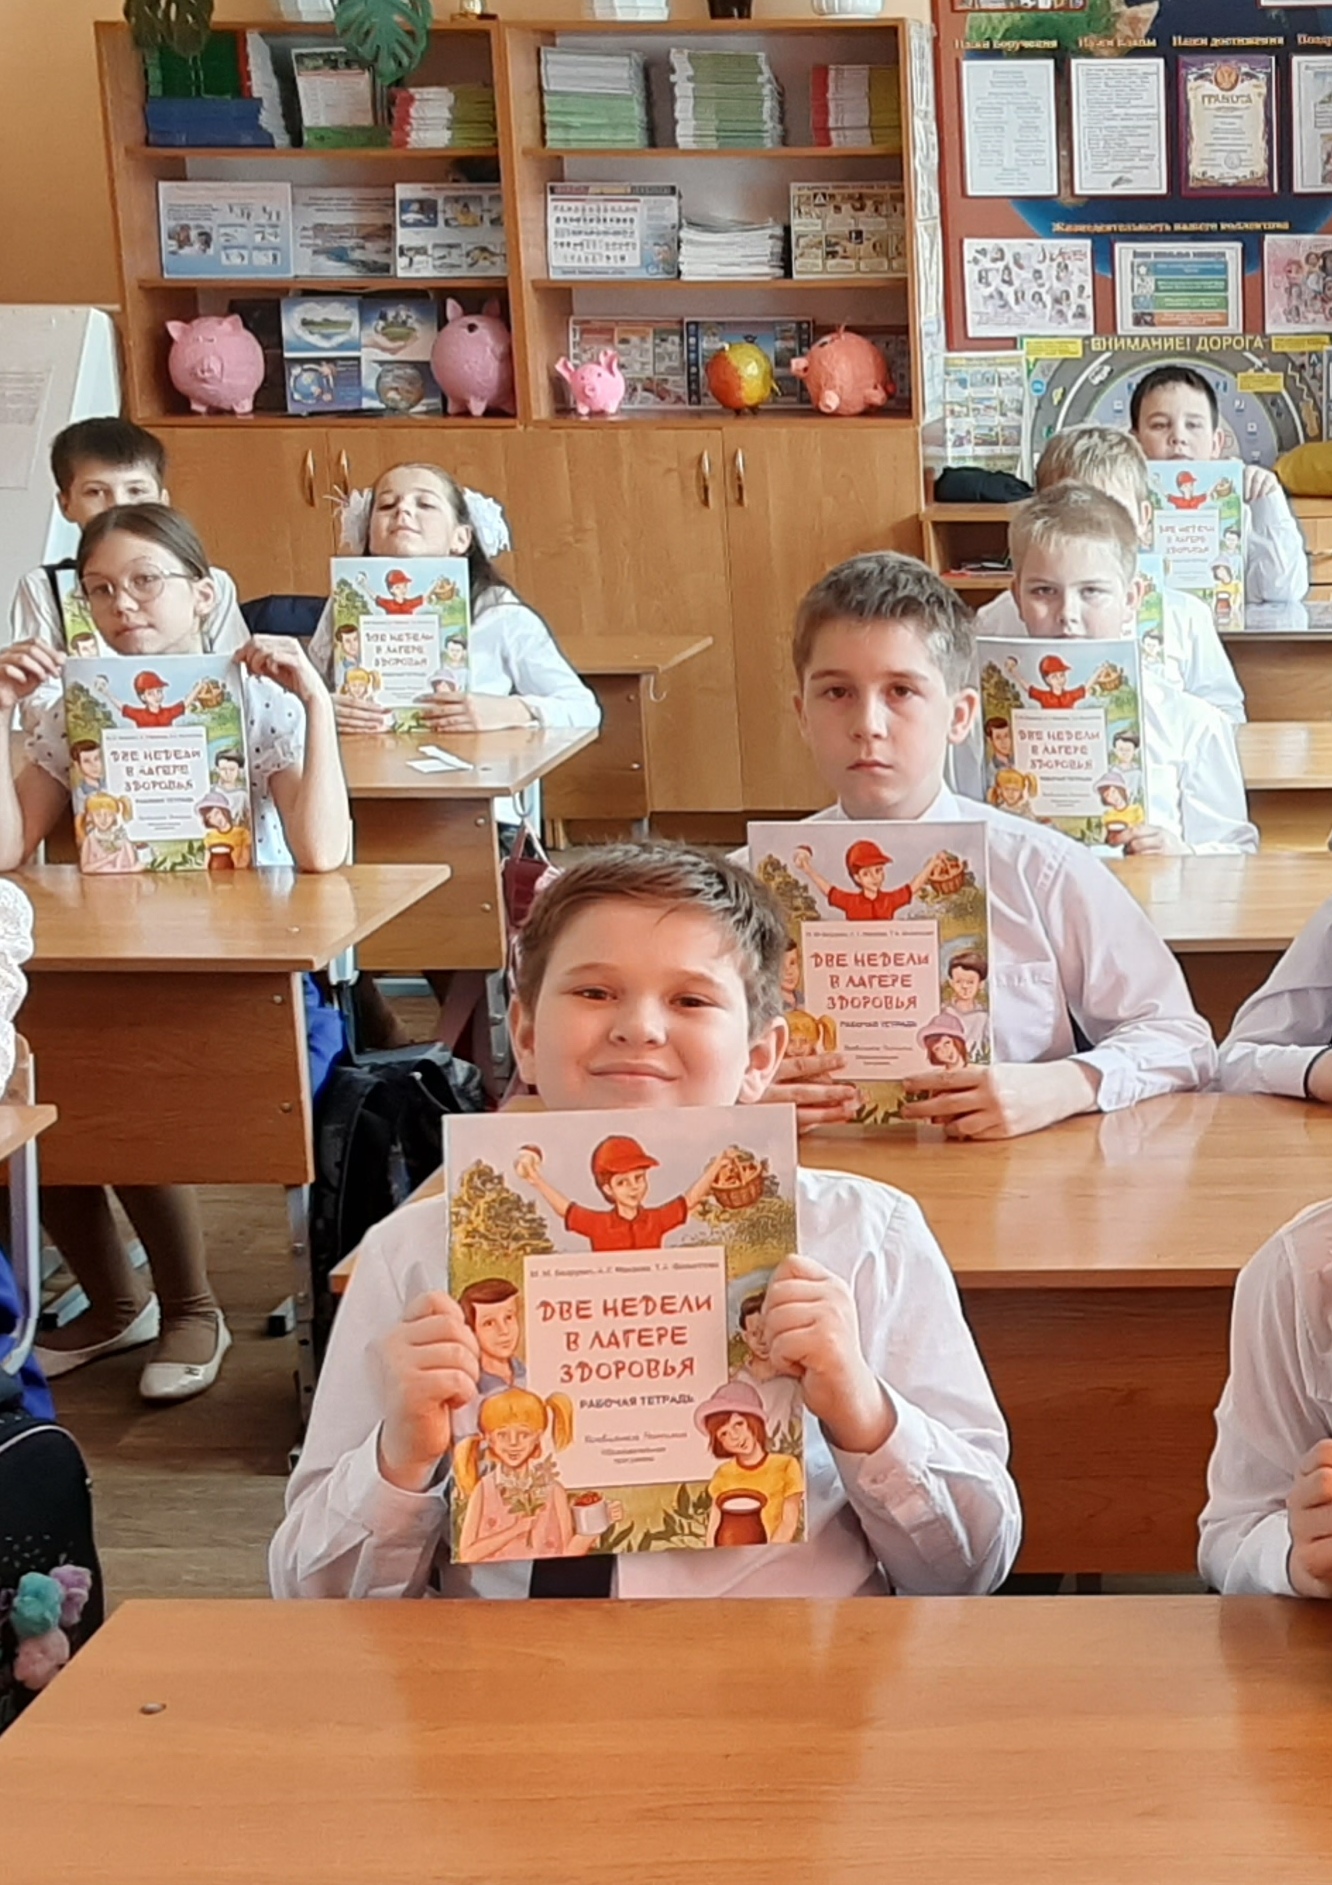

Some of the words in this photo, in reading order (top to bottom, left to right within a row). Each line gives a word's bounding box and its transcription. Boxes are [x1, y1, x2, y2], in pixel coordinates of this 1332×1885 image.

[1090, 336, 1192, 351] ВНИМАНИЕ!
[1195, 335, 1264, 352] ДОРОГА
[810, 952, 848, 968] ДВЕ
[854, 951, 930, 967] НЕДЕЛИ
[829, 974, 840, 989] В
[846, 974, 912, 989] ЛАГЕРЕ
[827, 995, 918, 1011] ЗДОРОВЬЯ
[536, 1300, 592, 1322] ДВЕ
[603, 1294, 712, 1318] НЕДЕЛИ
[565, 1331, 580, 1351] В
[589, 1326, 688, 1349] ЛАГЕРЕ
[560, 1356, 694, 1384] ЗДОРОВЬЯ
[580, 1396, 637, 1409] РАБОЧАЯ
[640, 1394, 695, 1406] ТЕТРАДЬ
